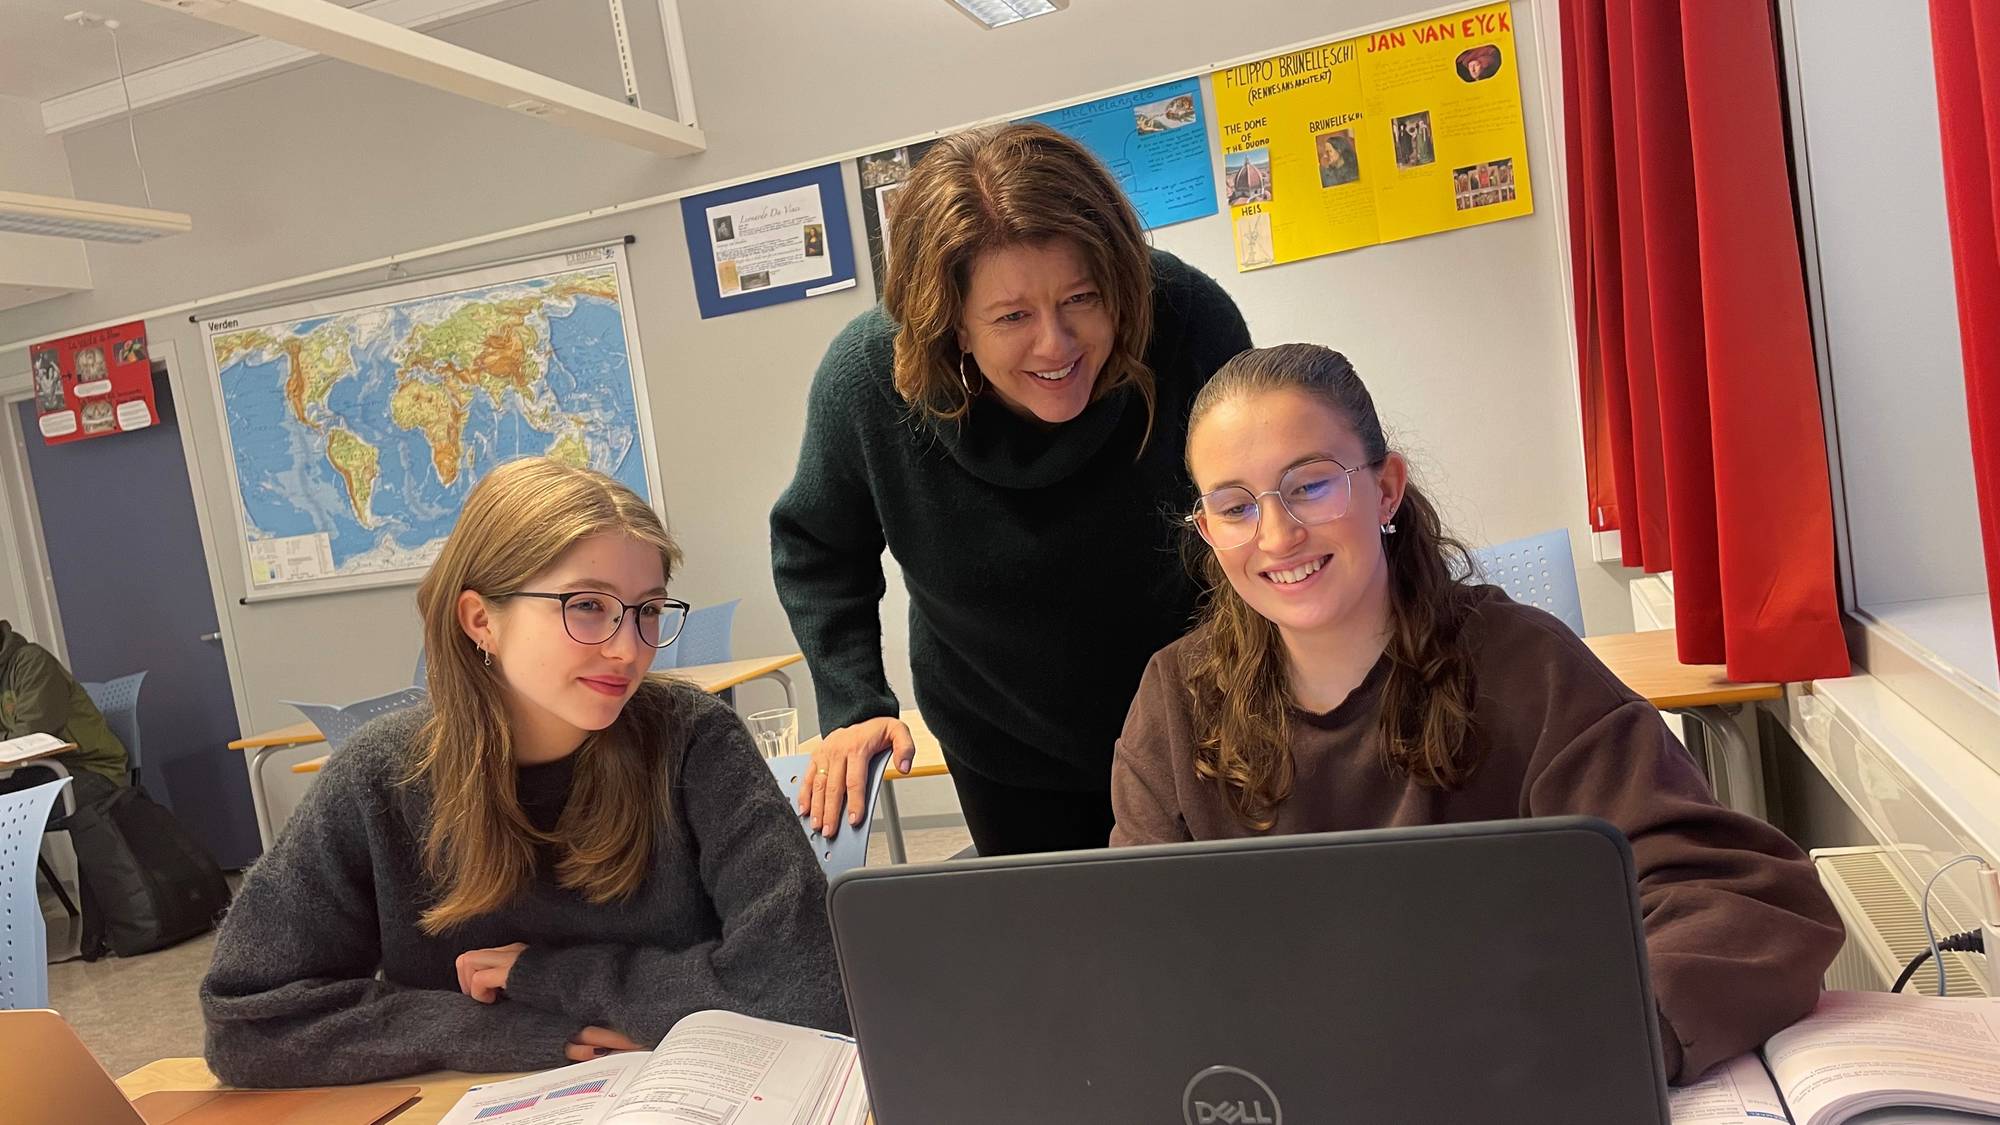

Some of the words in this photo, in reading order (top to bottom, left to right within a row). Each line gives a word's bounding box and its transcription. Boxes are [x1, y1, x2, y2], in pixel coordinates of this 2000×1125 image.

[1367, 31, 1406, 53] JAN
[1412, 23, 1455, 45] VAN
[1461, 12, 1510, 38] EYCK
[1226, 60, 1273, 88] FILIPPO
[1279, 44, 1354, 78] BRUNELLESCHI
[1224, 123, 1242, 136] THE
[1244, 117, 1268, 131] DOME
[1309, 112, 1364, 133] BRUNELLESCHI
[1240, 132, 1252, 143] OF
[1226, 144, 1243, 154] THE
[1241, 204, 1262, 216] HEIS
[208, 320, 239, 331] Verden
[1194, 1101, 1273, 1124] DELL
